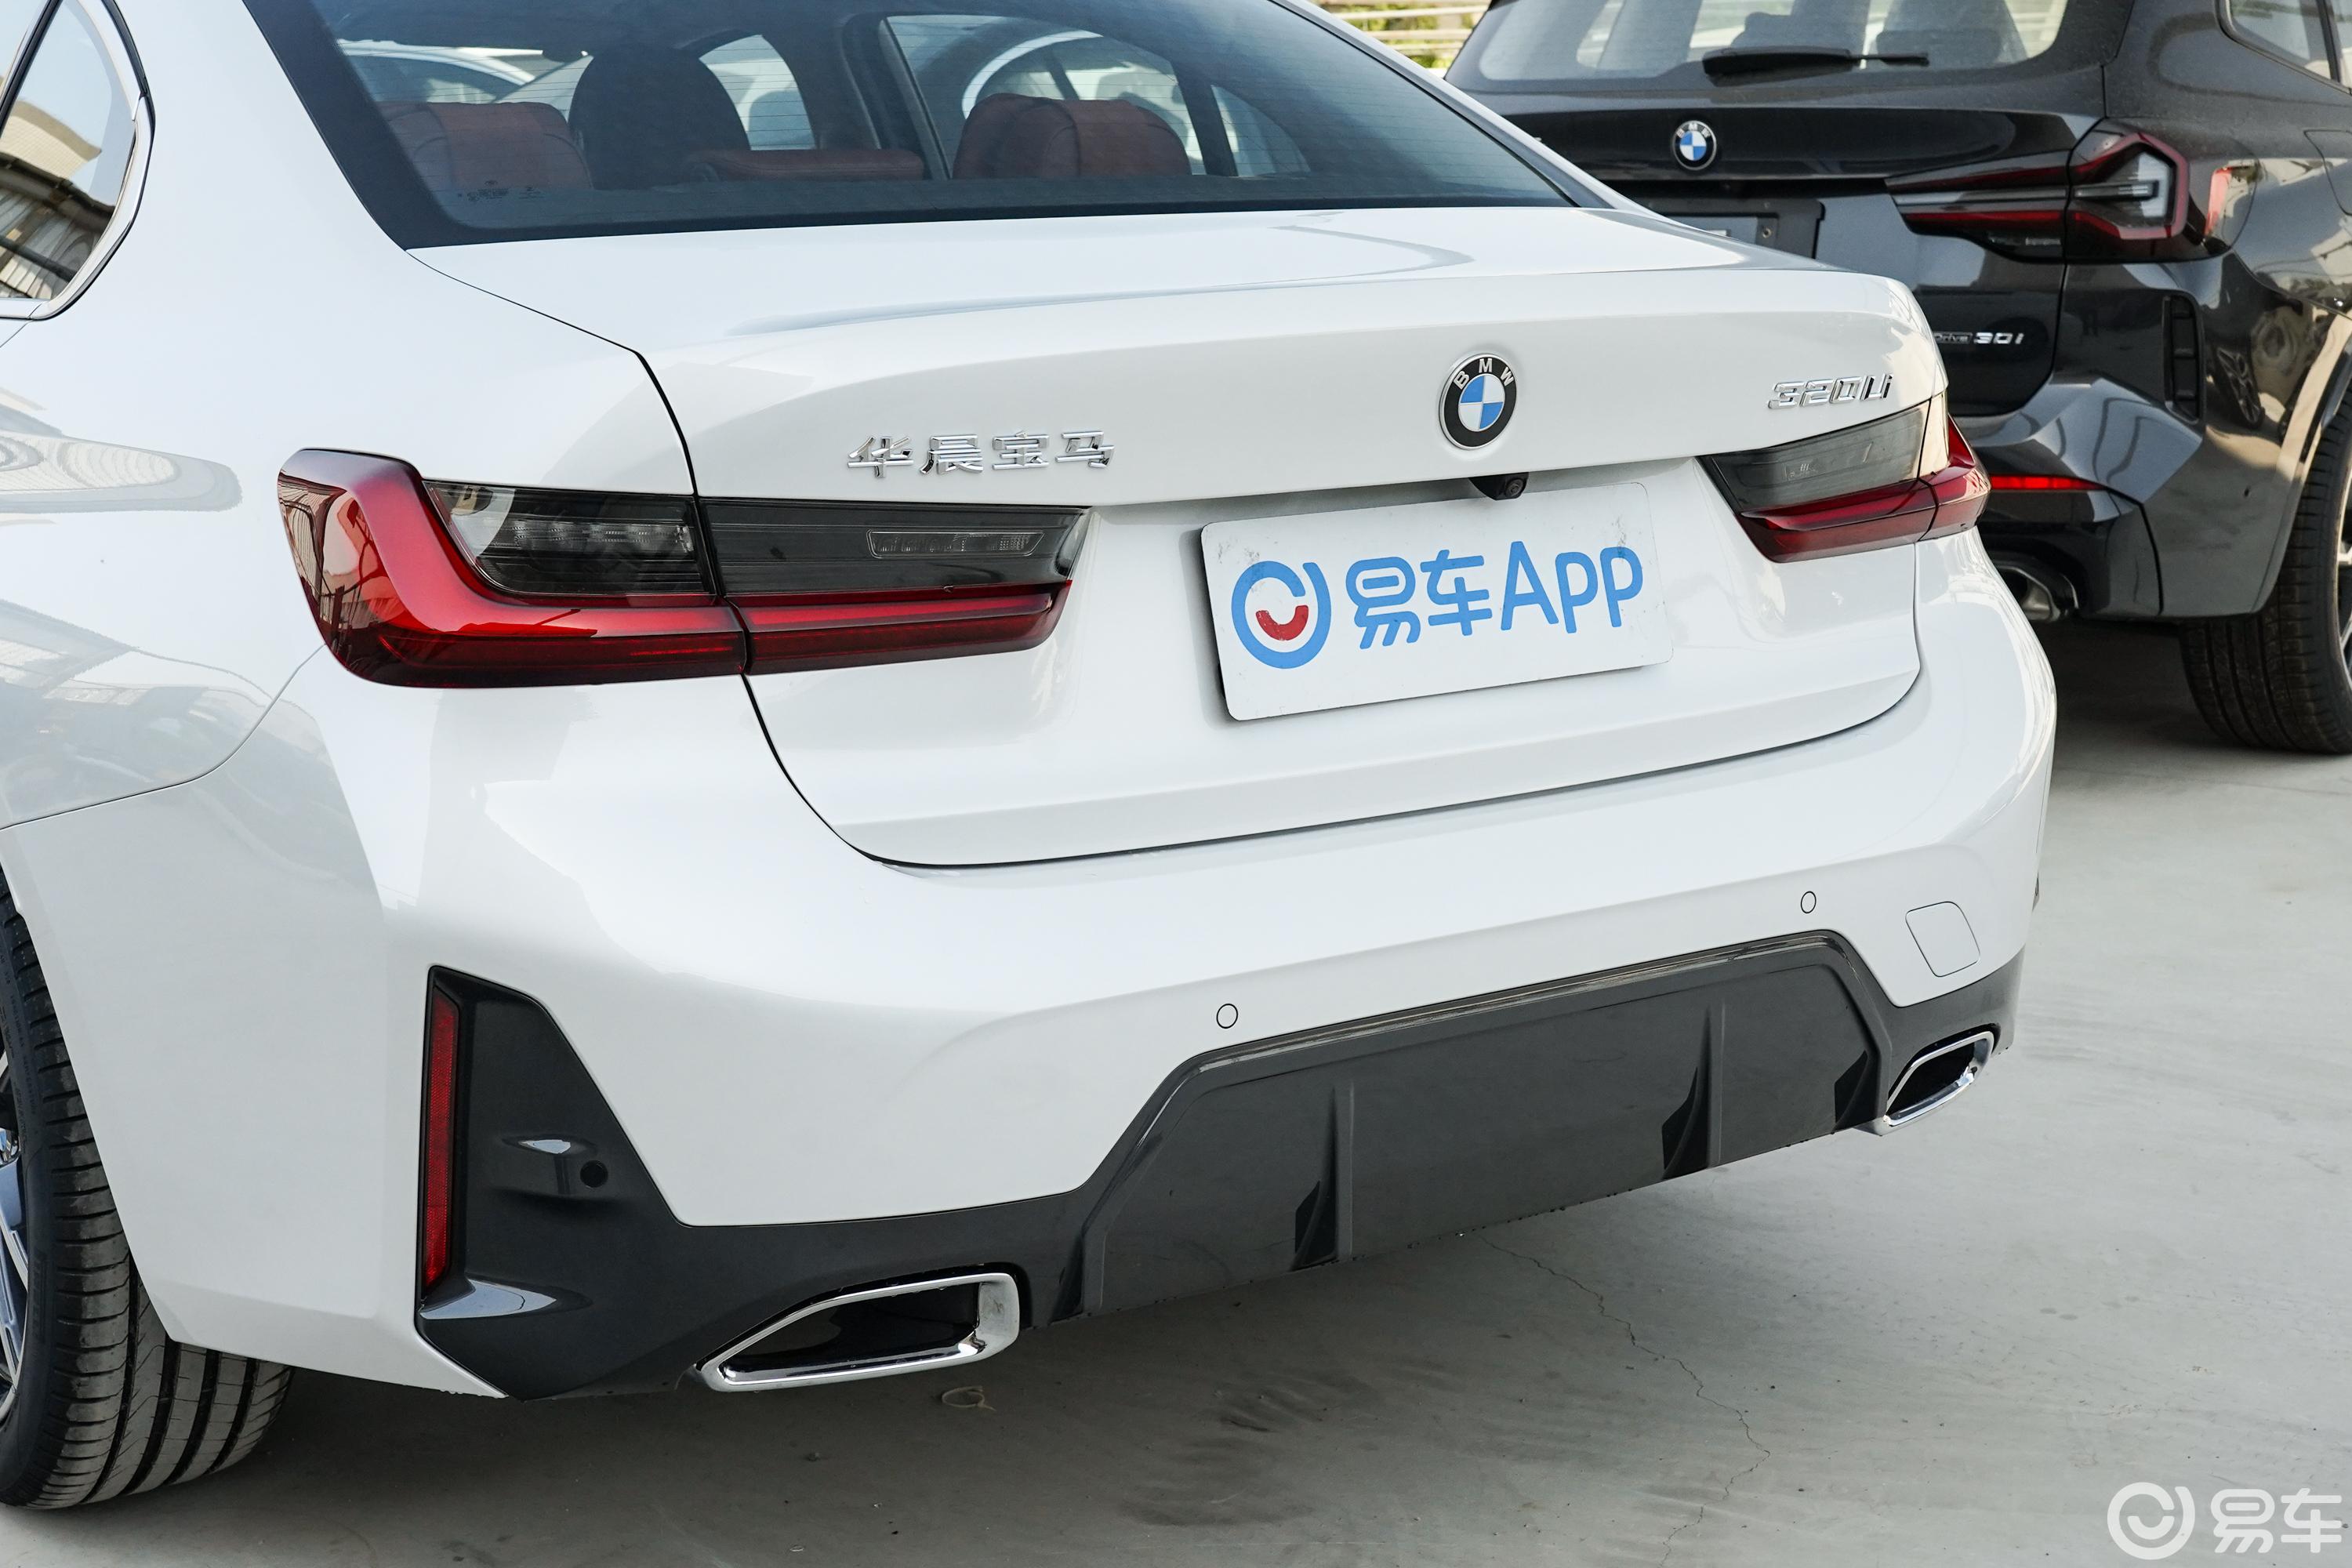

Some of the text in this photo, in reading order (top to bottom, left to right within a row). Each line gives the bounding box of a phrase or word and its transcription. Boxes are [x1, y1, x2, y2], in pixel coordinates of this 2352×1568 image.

[1676, 123, 1711, 139] BMW
[1933, 332, 1969, 343] Drive
[1453, 358, 1515, 390] BMW
[1767, 373, 1894, 409] 320Li
[847, 430, 1115, 478] 华晨宝马
[1345, 540, 1643, 649] 易车App
